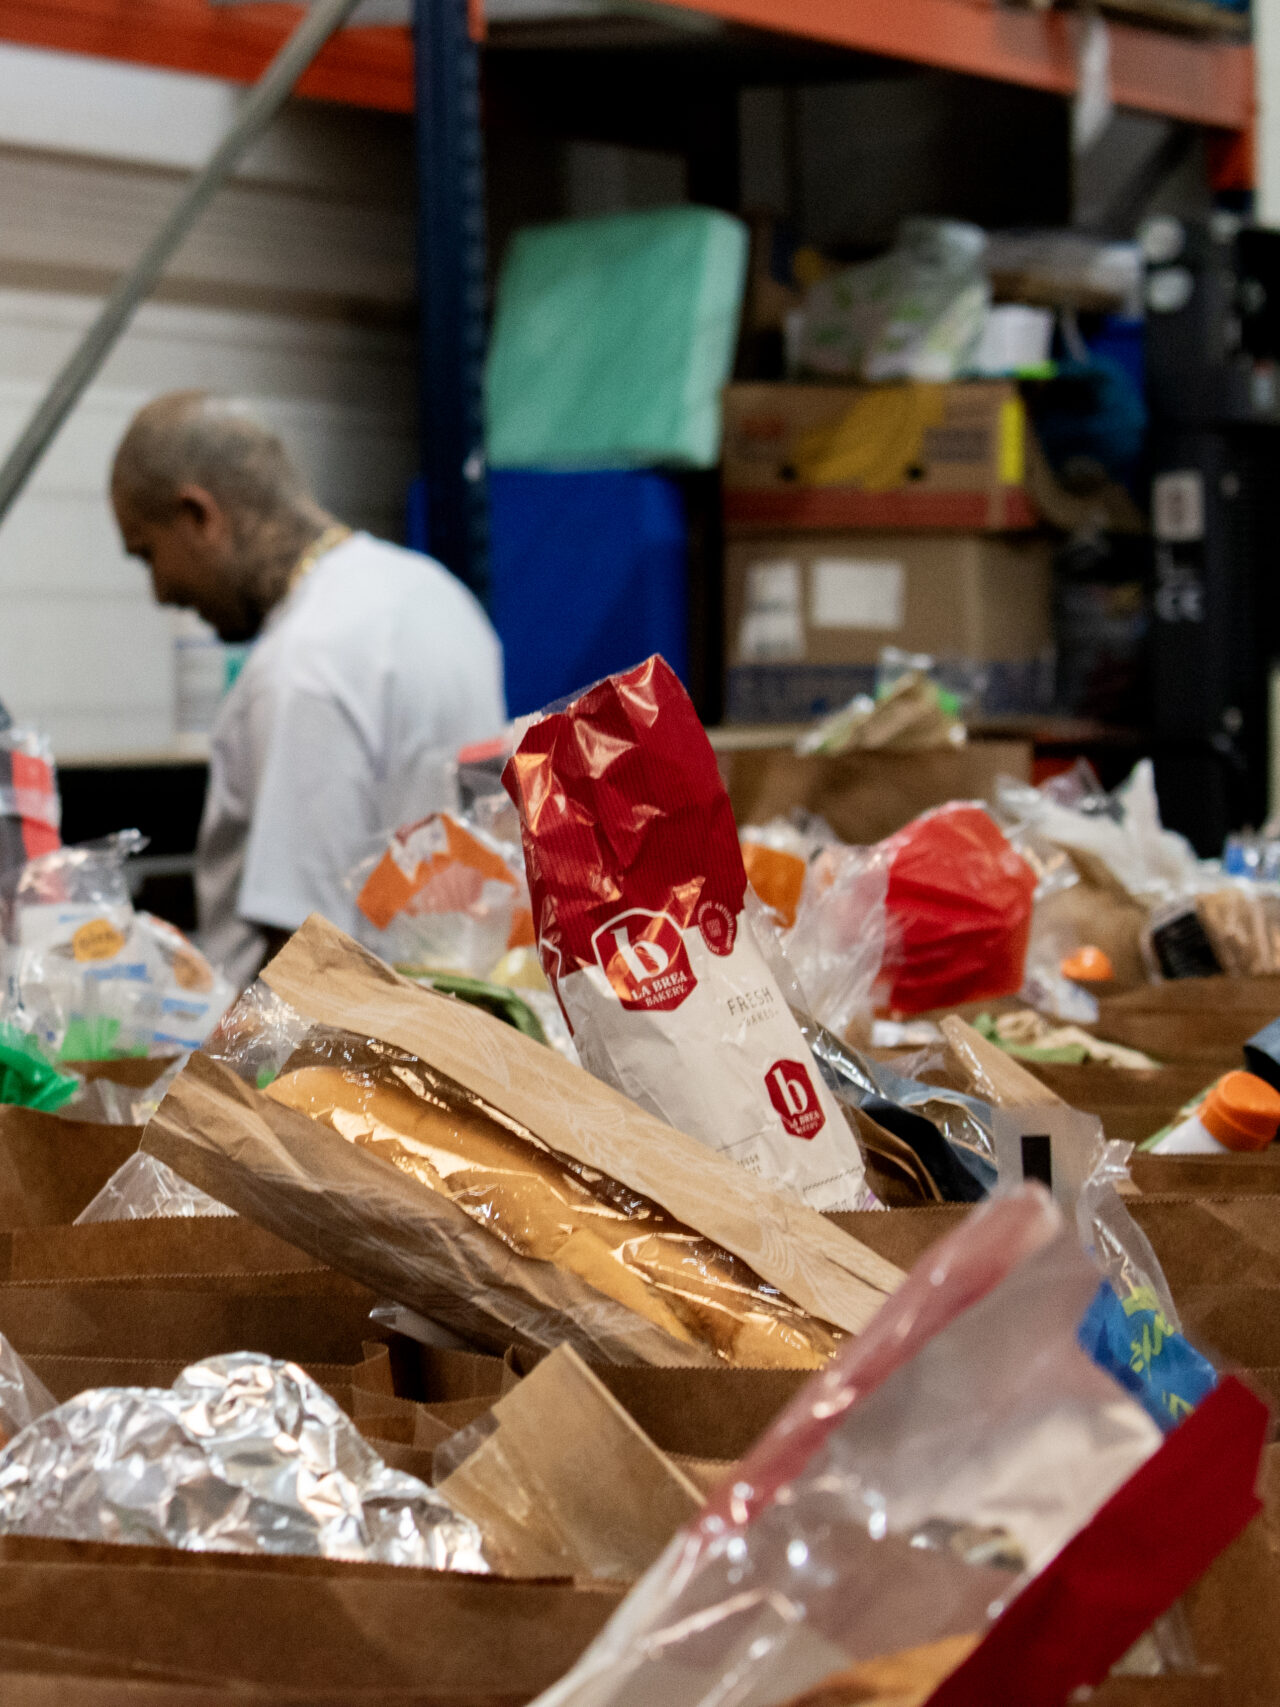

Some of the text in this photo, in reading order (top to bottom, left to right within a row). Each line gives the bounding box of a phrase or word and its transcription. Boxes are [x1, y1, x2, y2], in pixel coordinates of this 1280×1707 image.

[631, 970, 688, 1001] LA BREA
[645, 984, 687, 1008] BAKERY
[726, 986, 775, 1017] FRESH
